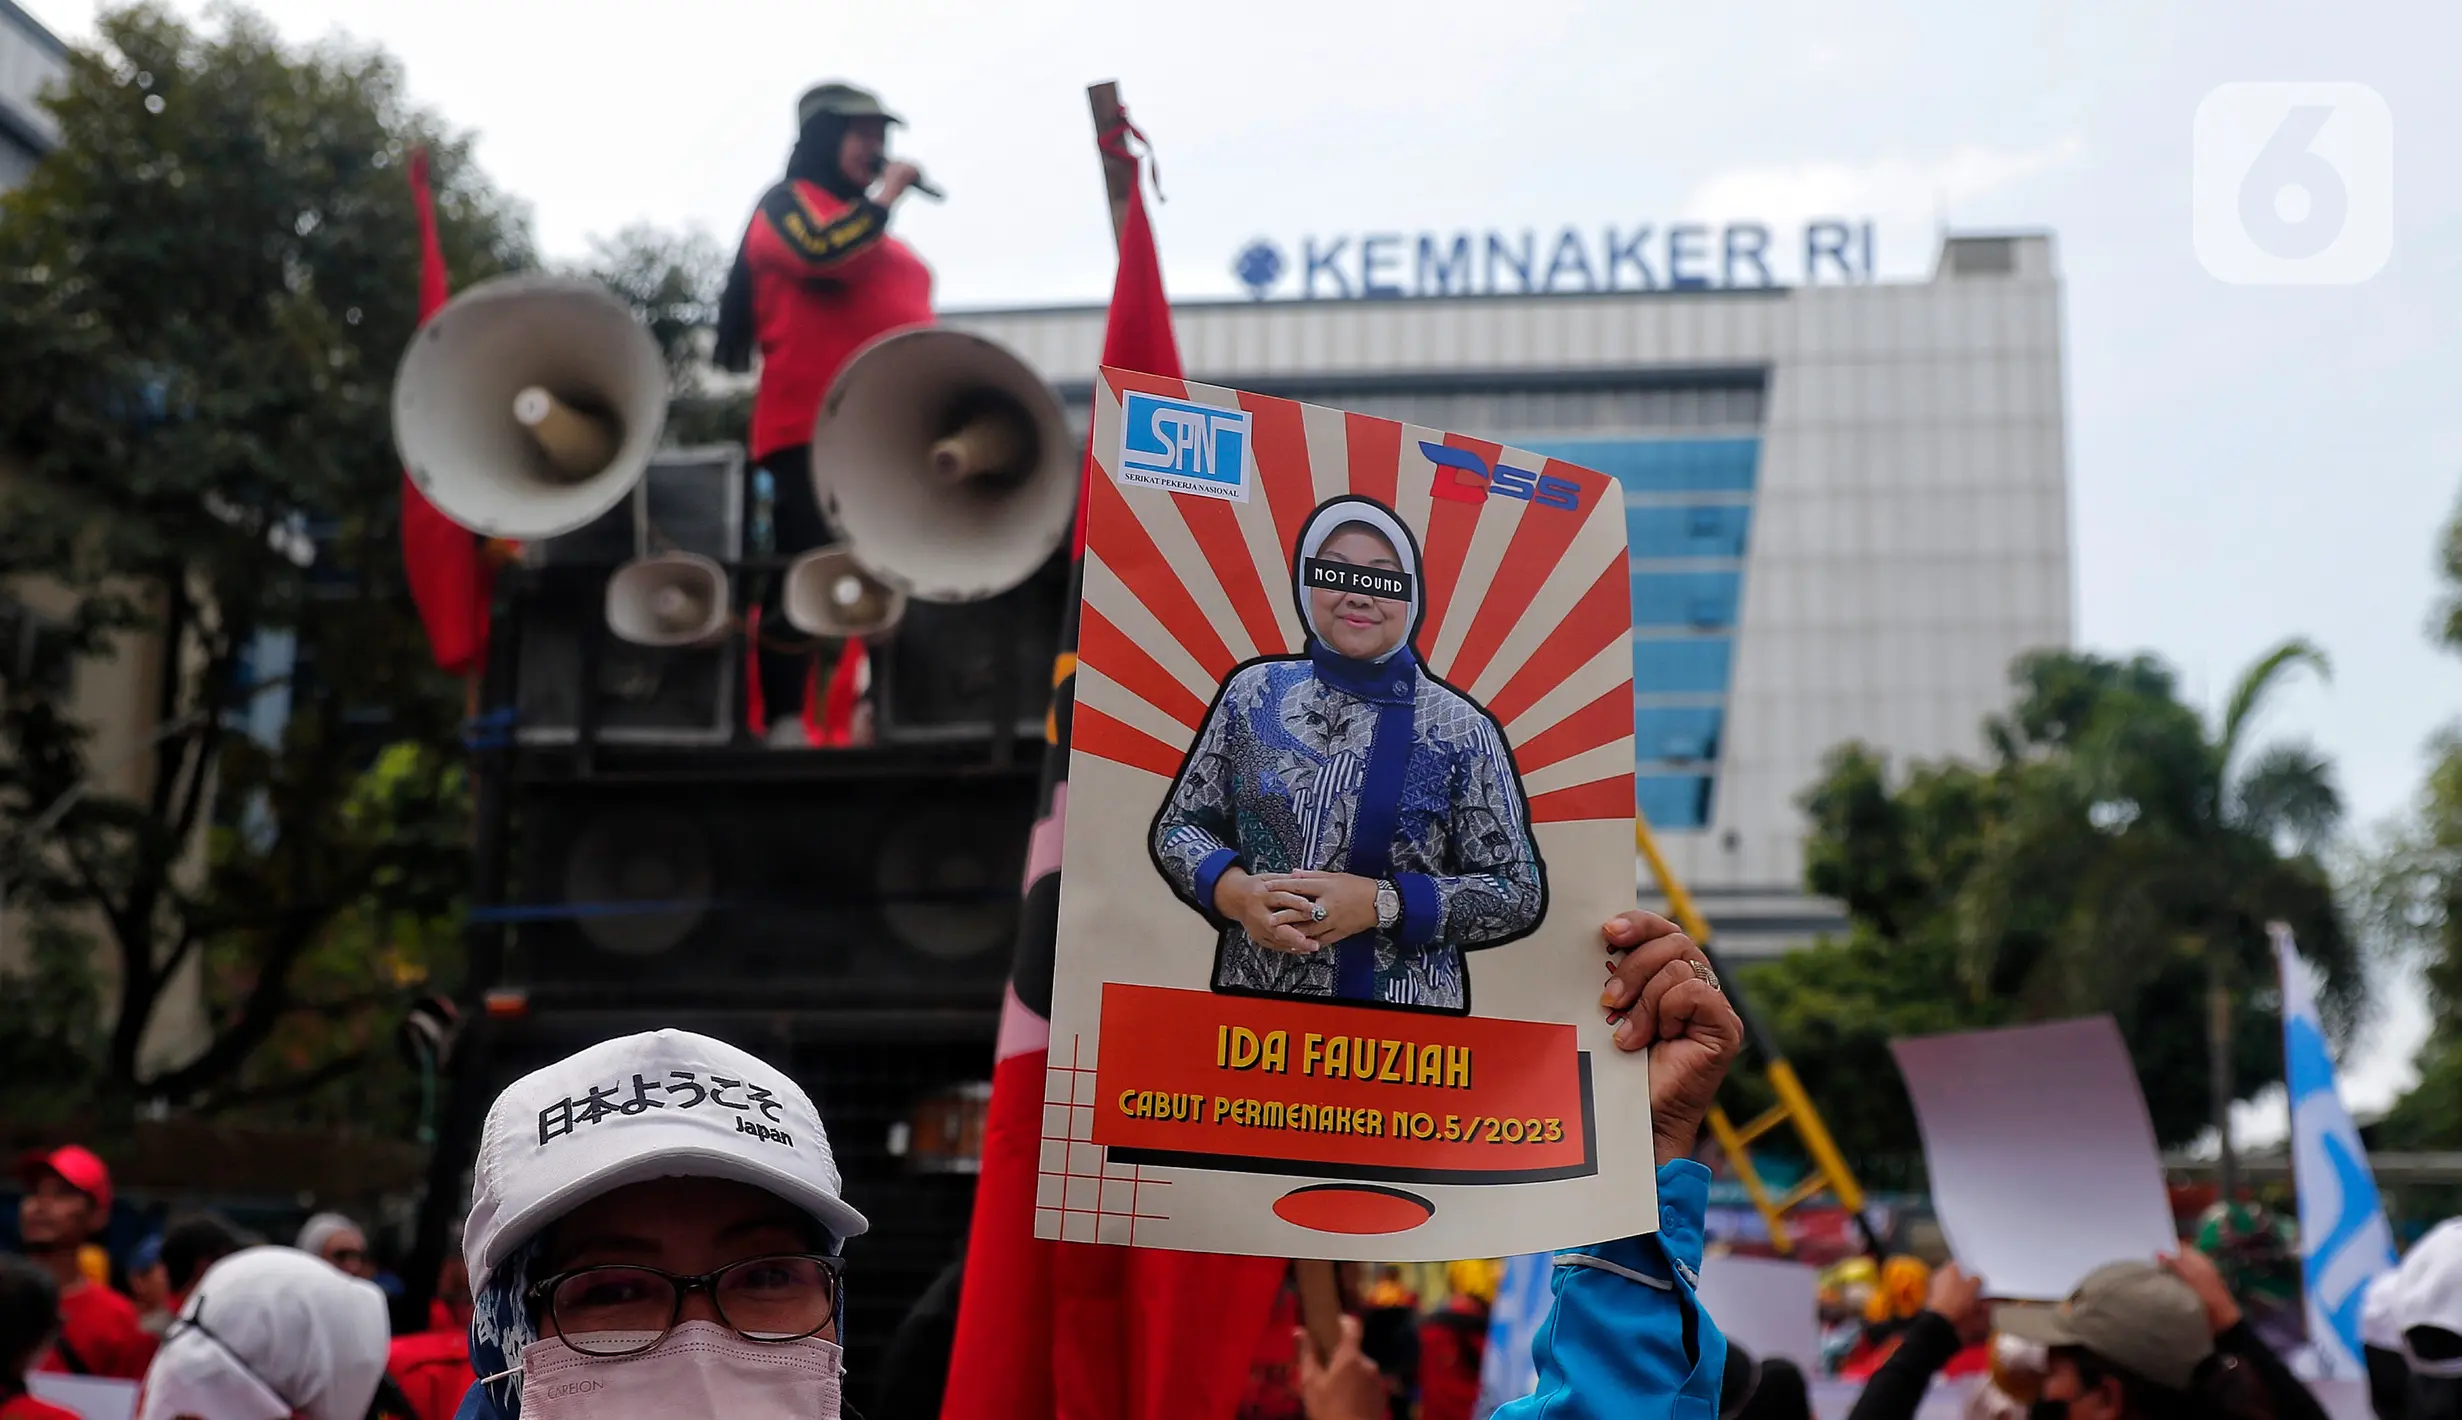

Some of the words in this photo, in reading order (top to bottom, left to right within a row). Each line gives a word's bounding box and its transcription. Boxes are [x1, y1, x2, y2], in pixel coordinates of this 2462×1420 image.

[1302, 223, 1774, 299] KEMNAKER
[1807, 219, 1877, 287] RI
[1126, 407, 1243, 475] SPN
[1124, 472, 1160, 485] SERIKAT
[1161, 478, 1197, 491] PEKERJA
[1199, 484, 1239, 498] NASIONAL
[1314, 567, 1346, 584] NOT
[1352, 573, 1402, 593] FOUND
[1216, 1024, 1288, 1074] IDA
[1302, 1032, 1471, 1088] FAUZIAH
[538, 1070, 783, 1146] 日本ようこそ
[735, 1115, 794, 1147] Japan
[1118, 1088, 1205, 1123] CABUT
[1213, 1095, 1384, 1138] PERMENAKER
[1391, 1110, 1564, 1144] NO.5/2023
